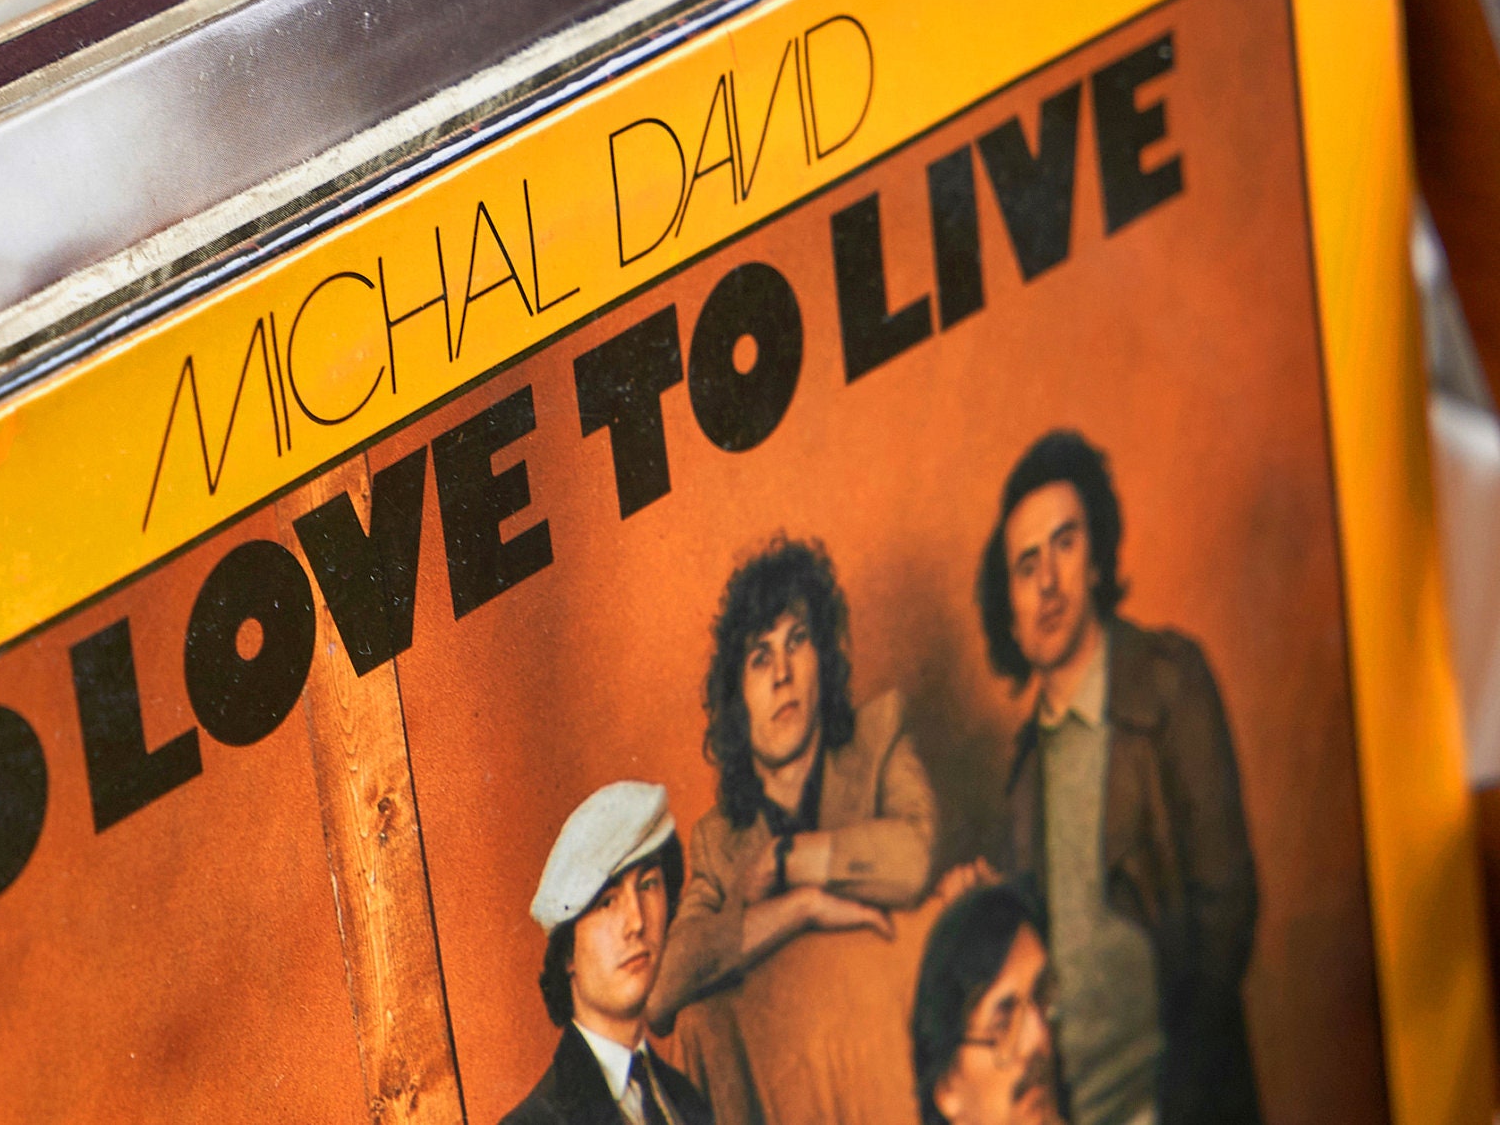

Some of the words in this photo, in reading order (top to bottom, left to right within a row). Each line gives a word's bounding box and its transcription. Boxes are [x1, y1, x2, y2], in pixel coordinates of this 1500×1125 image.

[70, 384, 554, 834] LOVE
[573, 261, 804, 521] TO
[830, 29, 1185, 386] LIVE
[142, 179, 580, 533] MICHAL
[609, 15, 875, 268] DAVID
